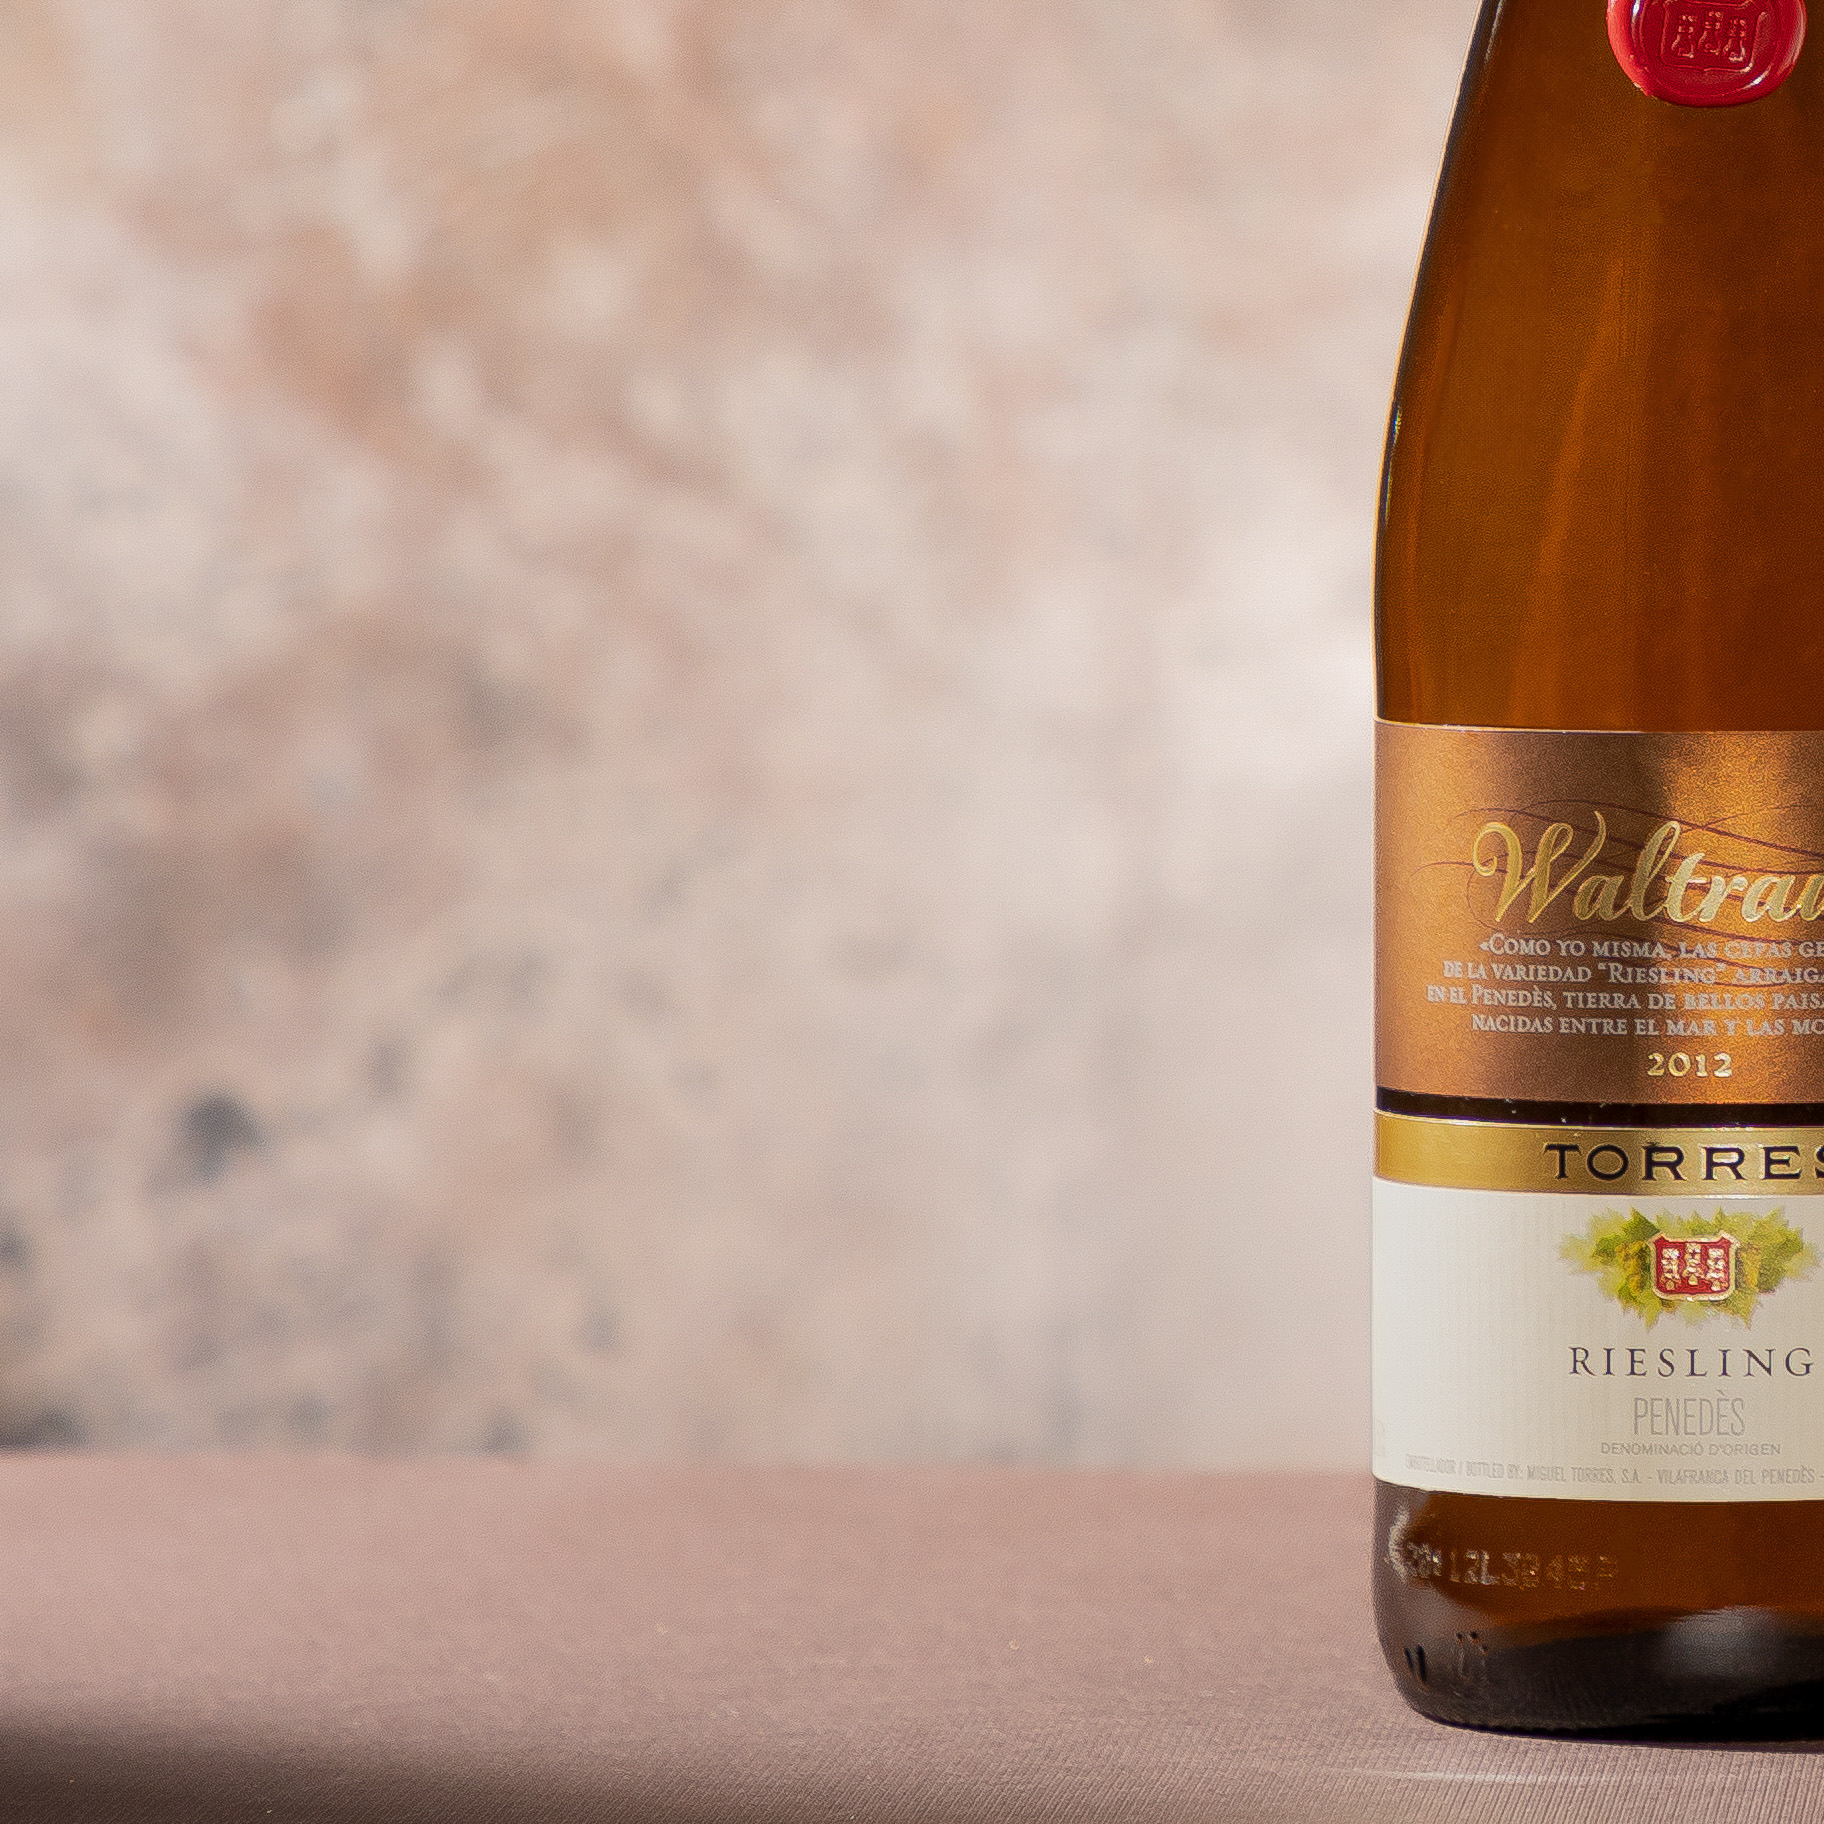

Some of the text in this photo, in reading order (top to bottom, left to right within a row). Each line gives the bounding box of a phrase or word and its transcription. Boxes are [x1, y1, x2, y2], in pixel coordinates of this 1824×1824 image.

[1557, 939, 1586, 957] YO
[1591, 940, 1672, 960] MISMA,
[1678, 941, 1717, 958] LAS
[1724, 941, 1792, 958] CEPAS
[1443, 960, 1462, 978] DE
[1467, 962, 1487, 980] LA
[1490, 963, 1592, 982] VARIEDAD
[1426, 985, 1446, 1002] EN
[1449, 987, 1466, 1004] EL
[1471, 984, 1558, 1010] PENEDÈS,
[1563, 992, 1643, 1010] TIERRA
[1647, 993, 1676, 1010] DE
[1683, 993, 1766, 1011] BELLOS
[1471, 1014, 1554, 1034] NACIDAS
[1559, 1017, 1629, 1035] ENTRE
[1634, 1018, 1661, 1036] EL
[1665, 1019, 1719, 1036] MAR
[1723, 1019, 1743, 1036] Y
[1747, 1019, 1786, 1036] LAS
[1647, 1052, 1733, 1078] 2012
[1568, 1346, 1815, 1378] RIESLING
[1632, 1388, 1746, 1437] PENEDÈS
[1600, 1441, 1782, 1456] DENOMINACIÓ D'ORIGEN
[1527, 1464, 1568, 1482] MIGUEL
[1656, 1468, 1729, 1485] VILAFRANCA
[1734, 1468, 1757, 1485] DEL
[1761, 1465, 1816, 1485] PENEDÈS
